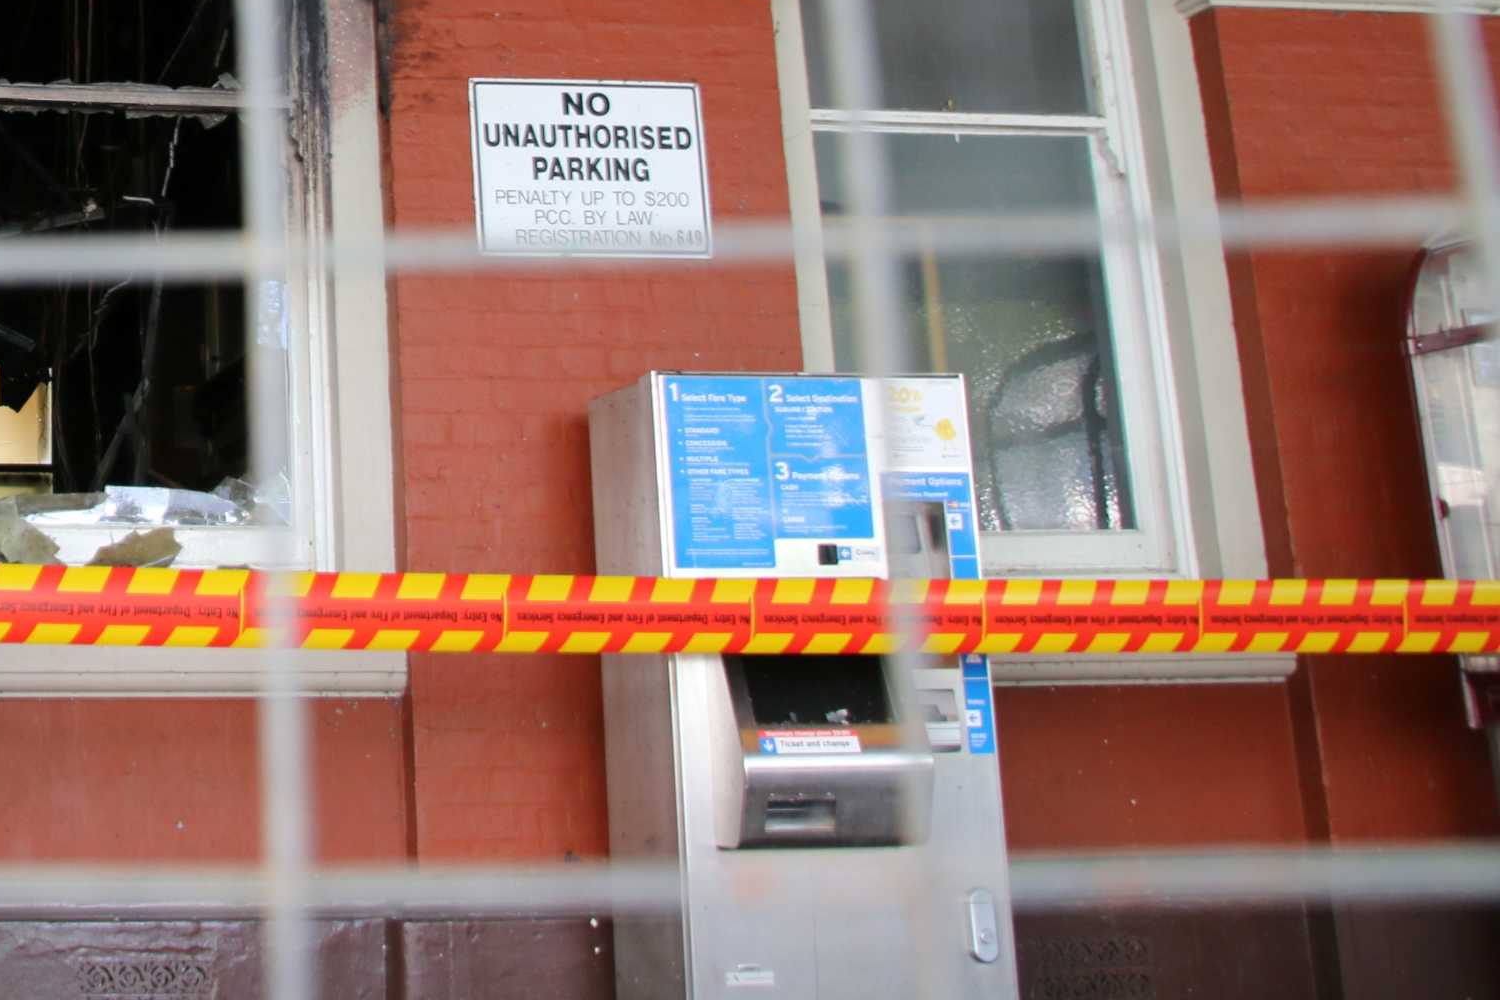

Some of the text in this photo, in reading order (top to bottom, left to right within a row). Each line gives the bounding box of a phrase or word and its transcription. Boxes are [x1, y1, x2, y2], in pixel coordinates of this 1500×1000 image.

[561, 92, 611, 117] NO
[483, 123, 692, 150] UNAUTHORISED
[531, 156, 651, 182] PARKING
[495, 189, 572, 205] PENALTY
[581, 190, 605, 206] UP
[612, 191, 636, 207] TO
[583, 210, 607, 225] BY
[616, 210, 653, 226] LAW
[515, 229, 642, 246] REGISTRATION
[668, 382, 678, 402] 1
[768, 384, 784, 403] 2
[774, 461, 789, 480] 3
[134, 605, 191, 618] Department
[403, 610, 458, 623] Department
[658, 613, 708, 625] Department
